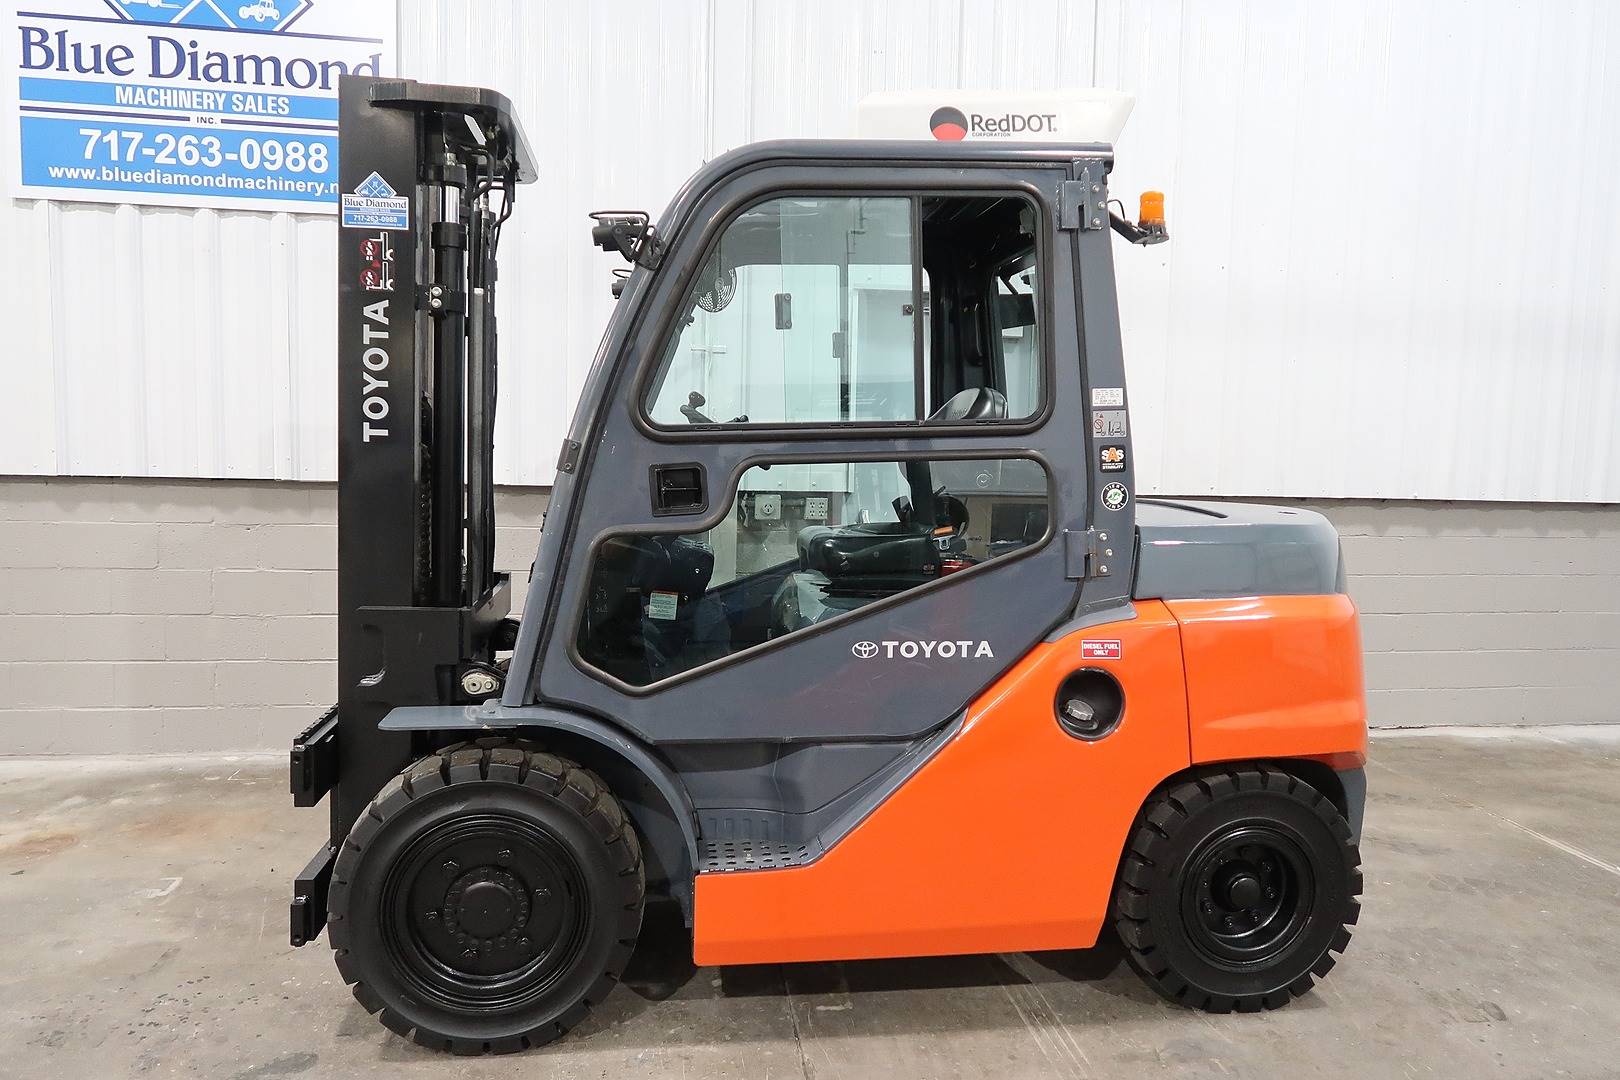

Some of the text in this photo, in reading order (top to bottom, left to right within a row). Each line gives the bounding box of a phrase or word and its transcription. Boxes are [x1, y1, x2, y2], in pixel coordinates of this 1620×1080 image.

[18, 25, 382, 90] Blue Diamond
[114, 85, 290, 115] MACHINERY SALES
[196, 116, 218, 125] INC.
[80, 128, 329, 174] 717-263-0988
[344, 198, 407, 209] Blue Diamond
[362, 299, 390, 443] TOYOTA
[1101, 447, 1125, 462] SAS
[881, 640, 994, 659] TOYOTA
